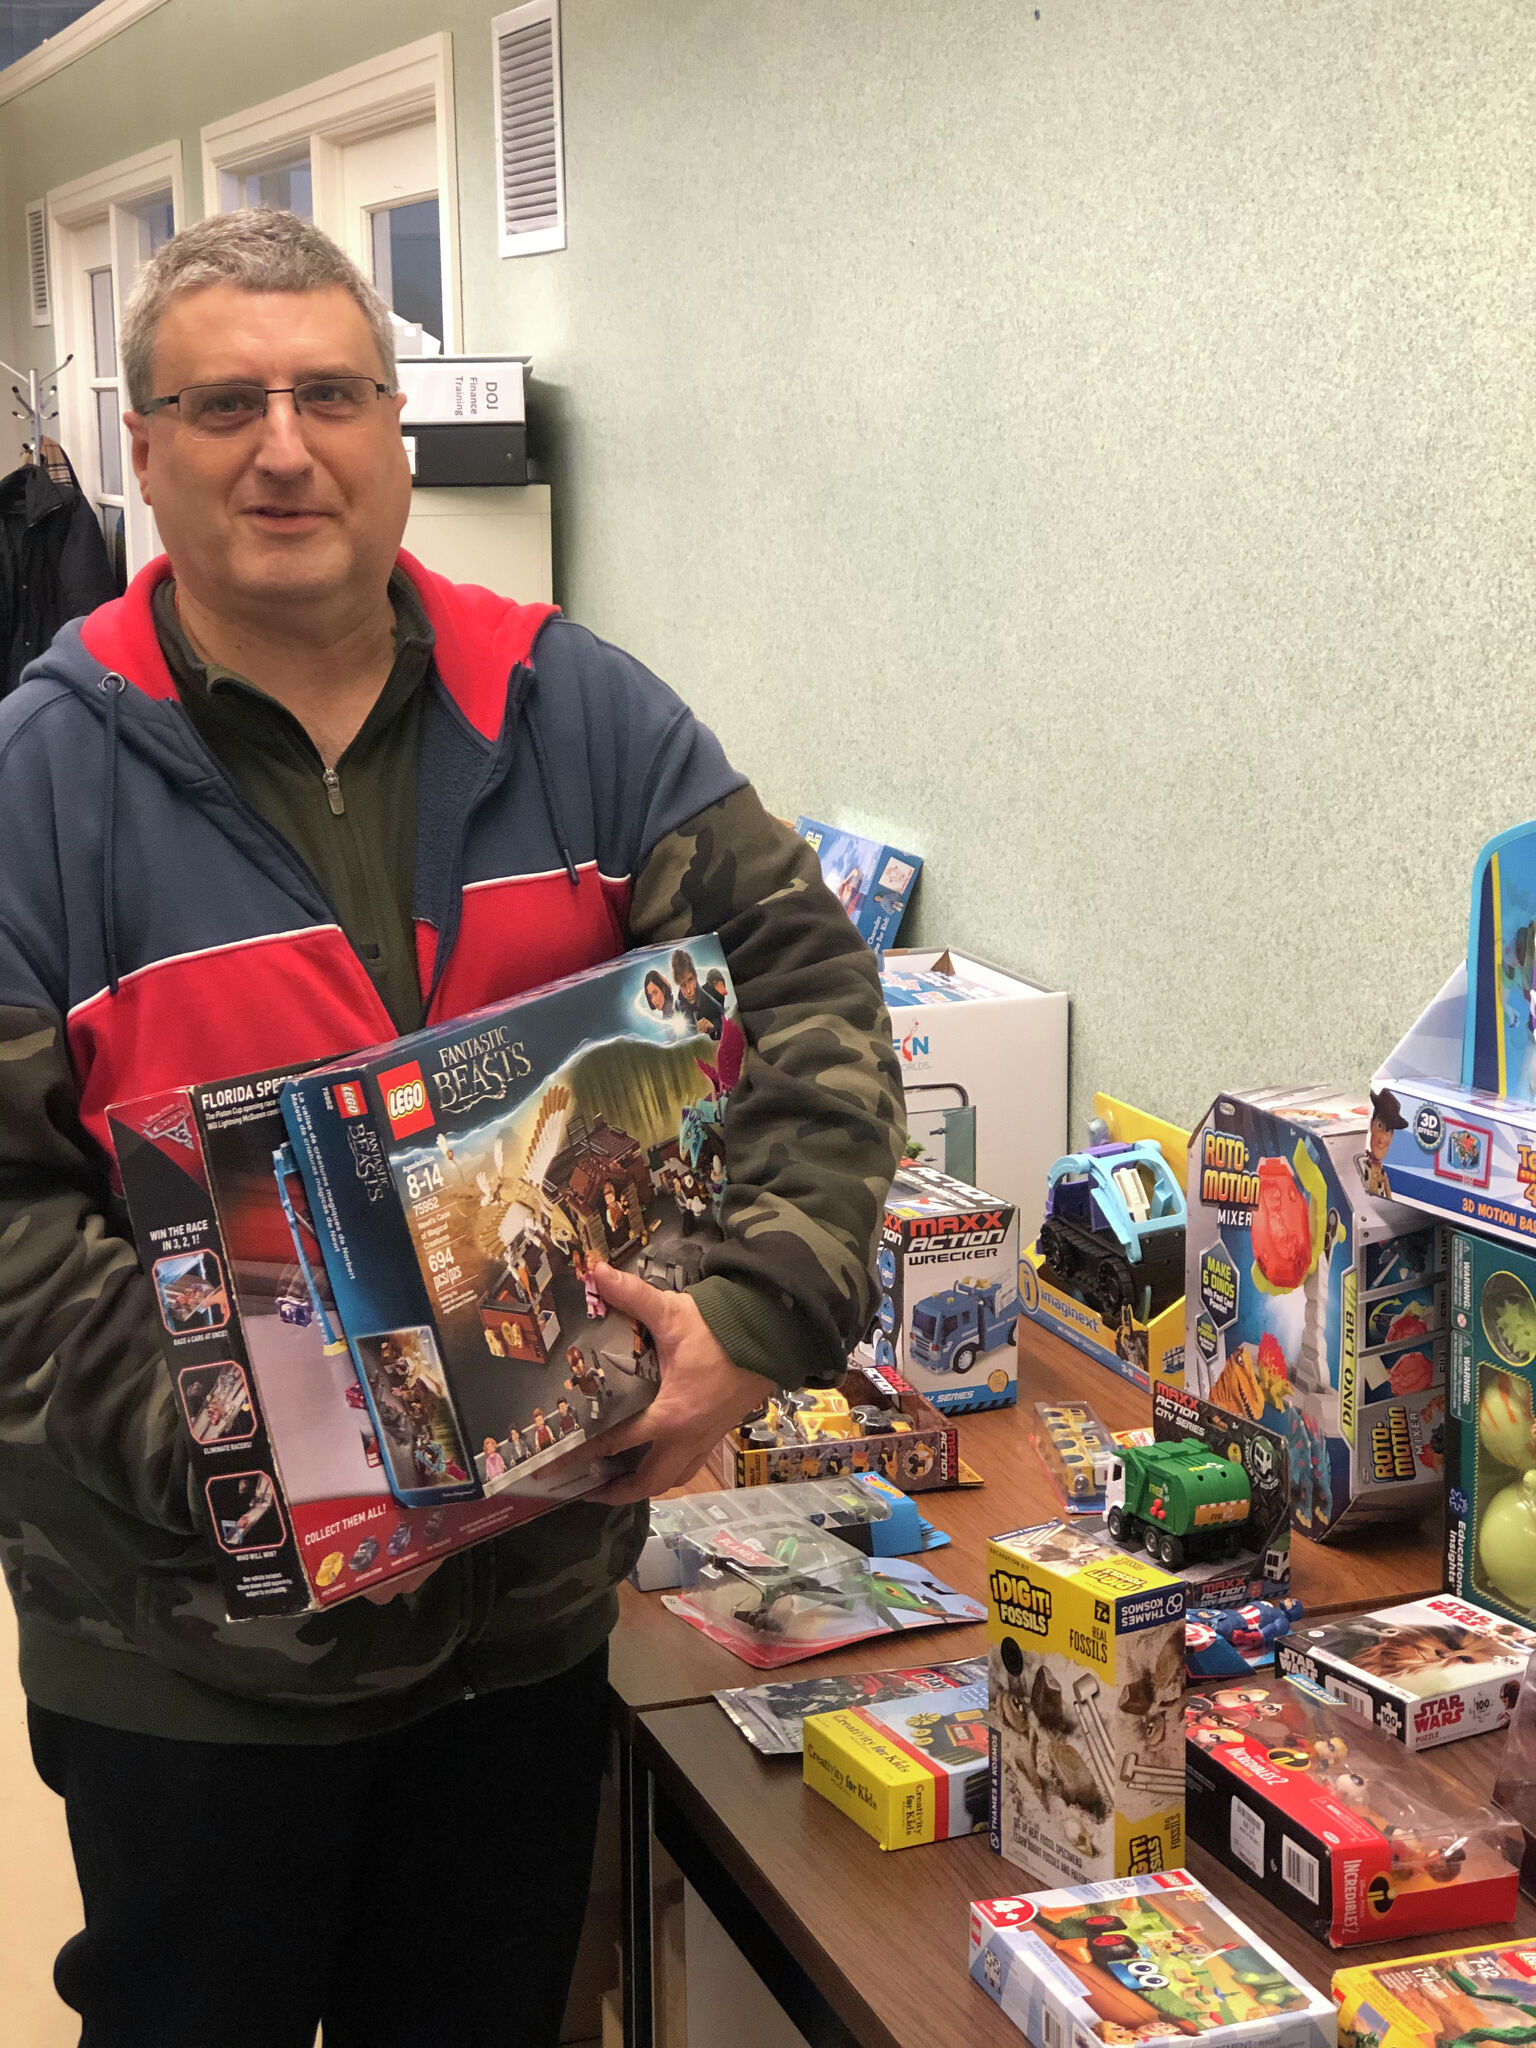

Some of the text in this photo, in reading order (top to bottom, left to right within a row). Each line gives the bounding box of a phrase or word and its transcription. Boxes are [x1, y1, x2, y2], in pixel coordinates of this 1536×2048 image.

[454, 376, 463, 416] Training
[470, 377, 478, 415] Finance
[486, 382, 498, 410] DOJ
[439, 1025, 511, 1068] FANTASTIC
[433, 1042, 532, 1110] BEASTS
[201, 1084, 255, 1111] FLORIDA
[341, 1085, 359, 1114] LEGO
[388, 1082, 424, 1118] LEGO
[1418, 1126, 1439, 1138] EFFECT!
[1420, 1113, 1438, 1128] 3D
[349, 1123, 384, 1201] BEASTS
[367, 1130, 390, 1189] FANTASTIC
[406, 1163, 444, 1199] 8-14
[1203, 1169, 1260, 1205] MOTION
[883, 1212, 903, 1233] XX
[910, 1211, 1003, 1237] MAXX
[1217, 1208, 1253, 1226] MIXER
[1462, 1198, 1475, 1214] 3D
[1477, 1203, 1517, 1227] MOTION
[150, 1219, 209, 1241] WIN THE RACE
[162, 1234, 200, 1251] IN 3, 2, 1!
[907, 1229, 1005, 1252] ACTION
[428, 1246, 455, 1273] 694
[909, 1248, 998, 1266] WRECKER
[1207, 1256, 1232, 1281] MAKE
[1202, 1269, 1235, 1299] 6 DINOS
[1040, 1286, 1099, 1334] imaginext
[1345, 1311, 1355, 1358] LAB
[862, 1366, 898, 1395] ACTION
[876, 1364, 915, 1392] MAXX
[937, 1390, 974, 1403] SERIES
[1155, 1395, 1199, 1422] ACTION
[1156, 1382, 1200, 1411] MAXX
[1343, 1370, 1354, 1427] DINO
[1155, 1407, 1206, 1437] CITY SERIES
[1411, 1412, 1424, 1456] MIXER
[1389, 1406, 1414, 1477] MOTION
[304, 1503, 387, 1546] COLLECT THEM ALL!
[1448, 1529, 1457, 1583] Insights
[1456, 1520, 1466, 1597] Educationa
[1200, 1585, 1247, 1600] ACTION
[1202, 1578, 1246, 1593] MAXX
[1000, 1603, 1047, 1634] FOSSILS
[1096, 1607, 1109, 1620] 7+
[1121, 1597, 1164, 1615] KOSMOS
[1121, 1609, 1166, 1628] THAMES
[1426, 1601, 1483, 1627] WARS
[1433, 1600, 1493, 1625] STAR
[1069, 1628, 1108, 1664] FOSSILS
[1092, 1626, 1108, 1643] REAL
[1279, 1647, 1315, 1669] STAR
[1279, 1658, 1319, 1682] WARS
[1382, 1711, 1397, 1727] 100
[1413, 1694, 1465, 1720] STAR
[1475, 1699, 1490, 1711] 100
[1413, 1707, 1465, 1734] WARS
[833, 1714, 910, 1775] Creativity for Kids
[1415, 1731, 1440, 1743] PUZZLE
[807, 1743, 878, 1811] Creativity for Kids
[1224, 1747, 1278, 1786] INCREDIBLES
[906, 1794, 915, 1836] for Kids
[915, 1783, 925, 1836] Creativity
[1170, 1813, 1181, 1850] FOSSILS
[1343, 1858, 1362, 1927] INCREDIBLES
[1341, 1927, 1360, 1935] 2
[1468, 1956, 1500, 1979] 7-12
